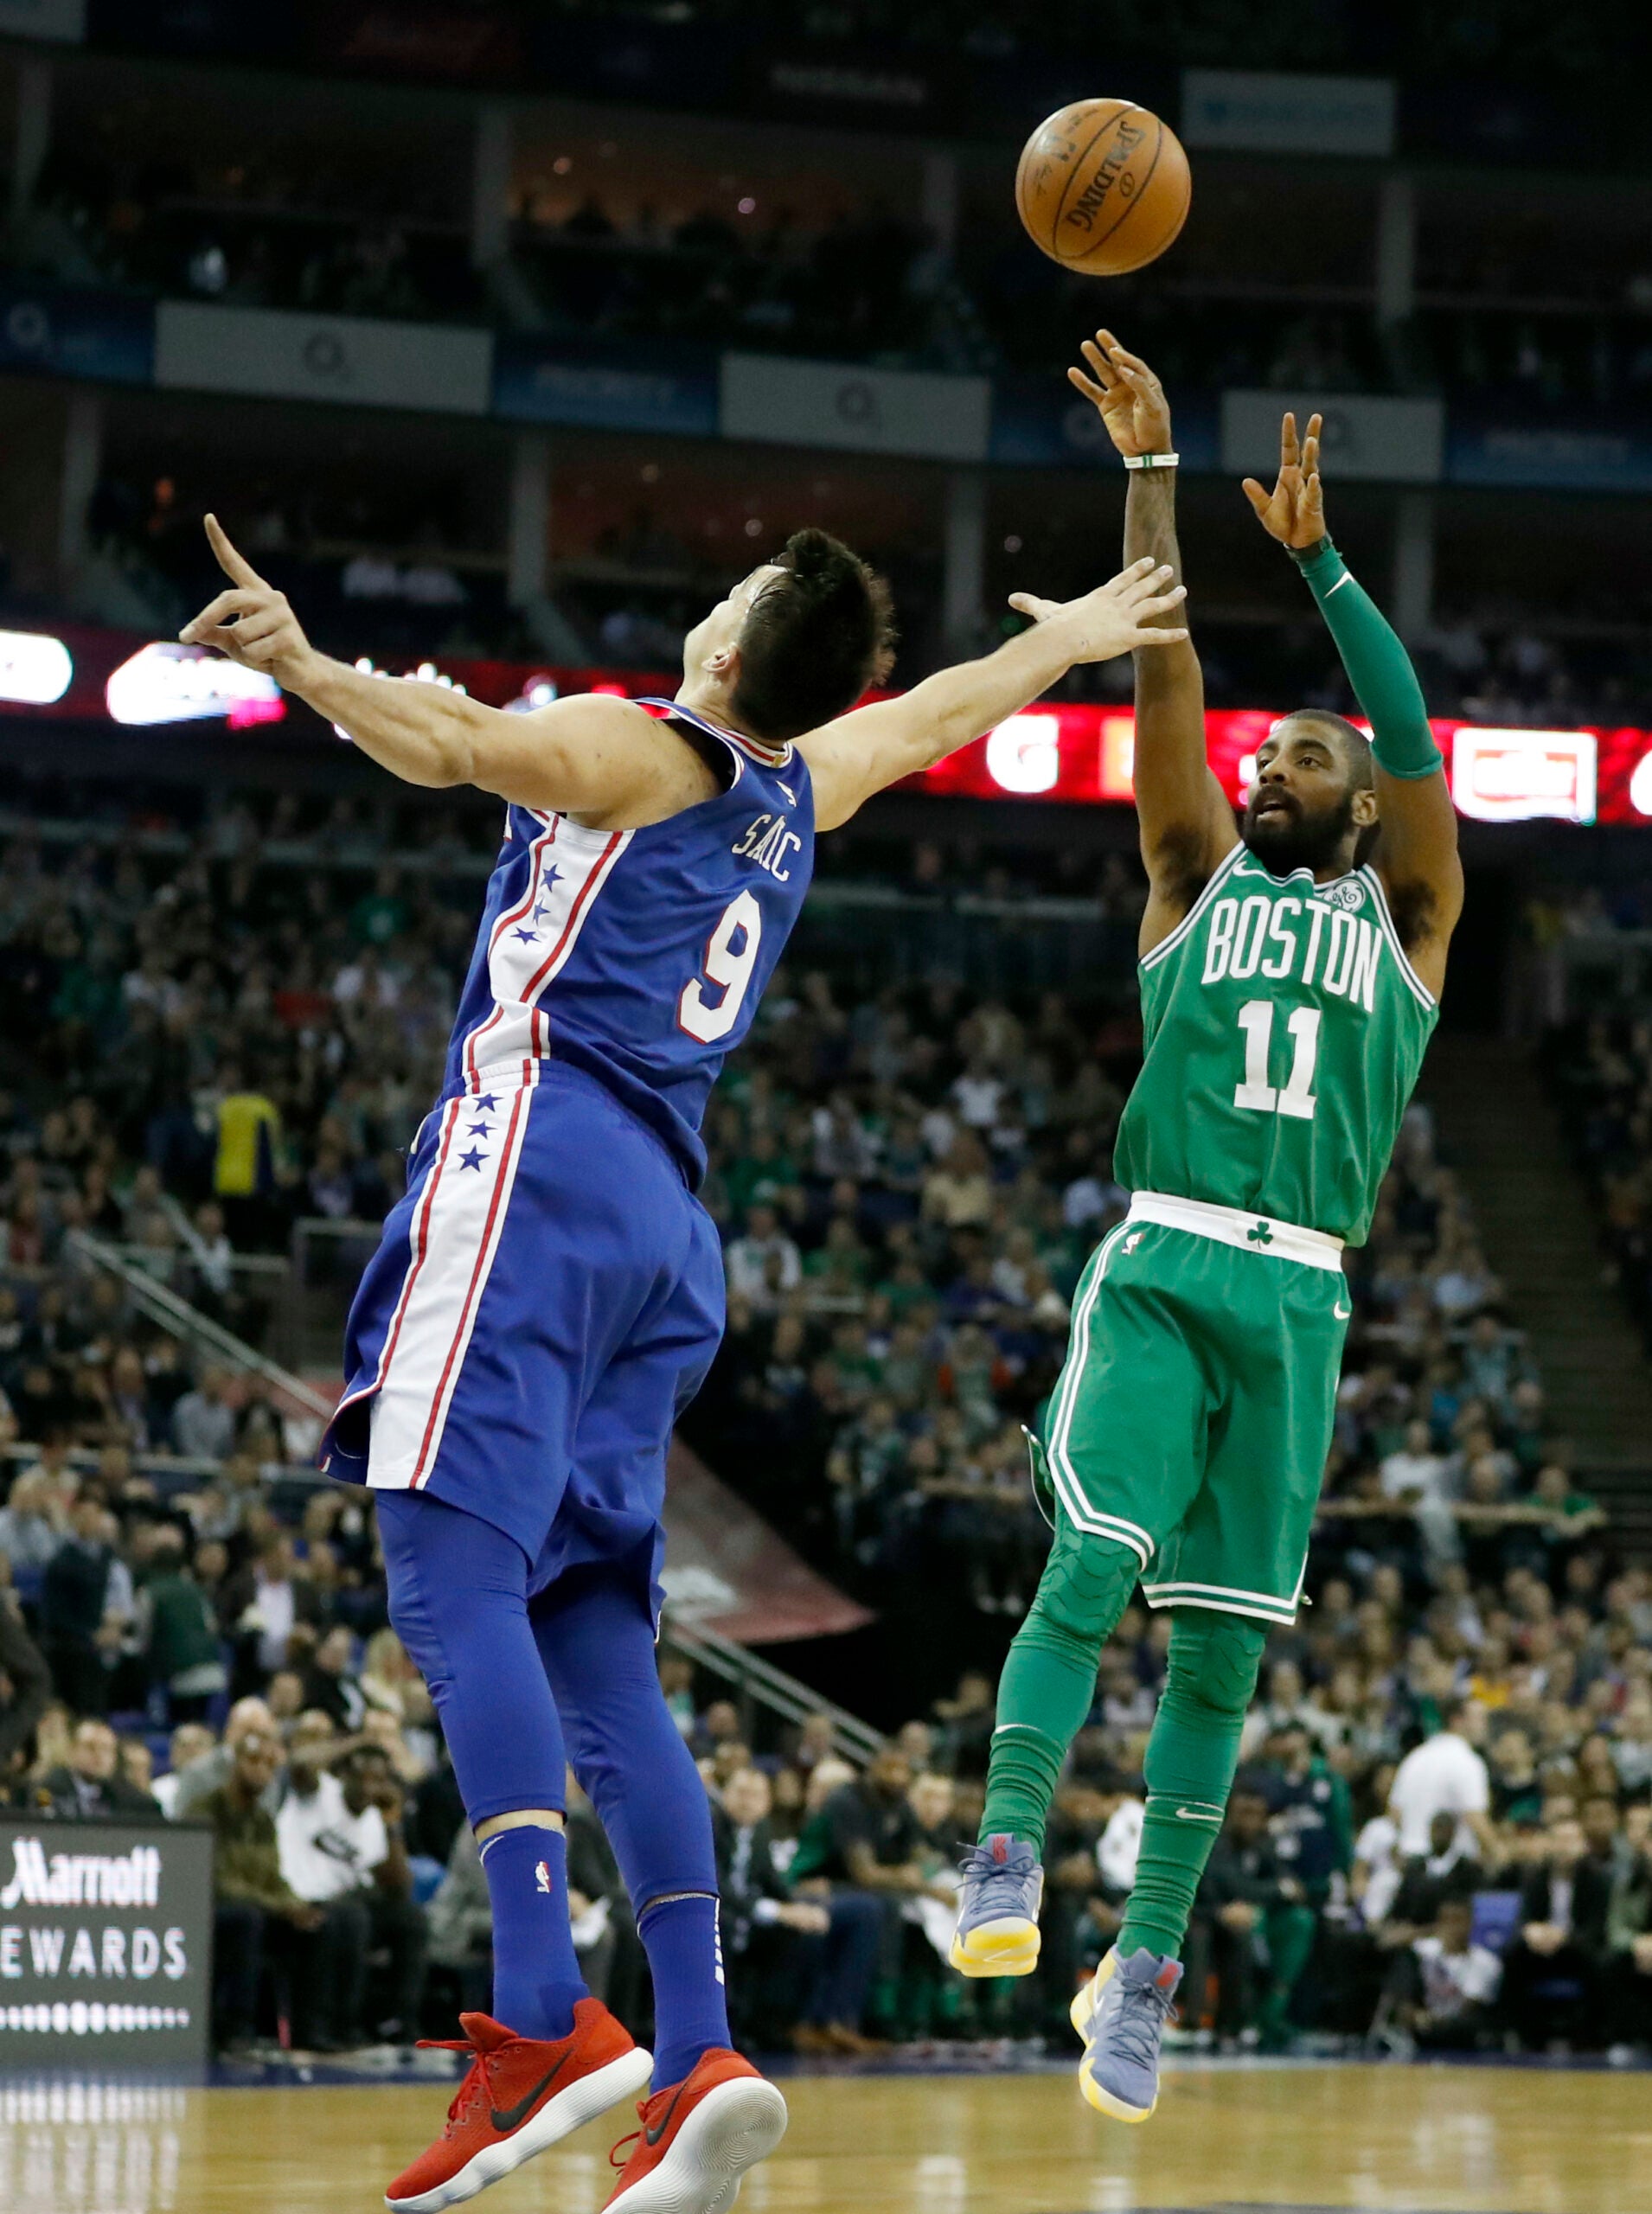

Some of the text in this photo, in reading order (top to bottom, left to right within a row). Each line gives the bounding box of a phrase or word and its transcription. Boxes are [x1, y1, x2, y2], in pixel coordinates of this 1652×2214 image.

[1066, 121, 1145, 233] SPALDING
[677, 888, 762, 1045] 9
[1201, 895, 1383, 1013] BOSTON
[1233, 1000, 1322, 1119] 11
[0, 1925, 188, 1980] EWARDS
